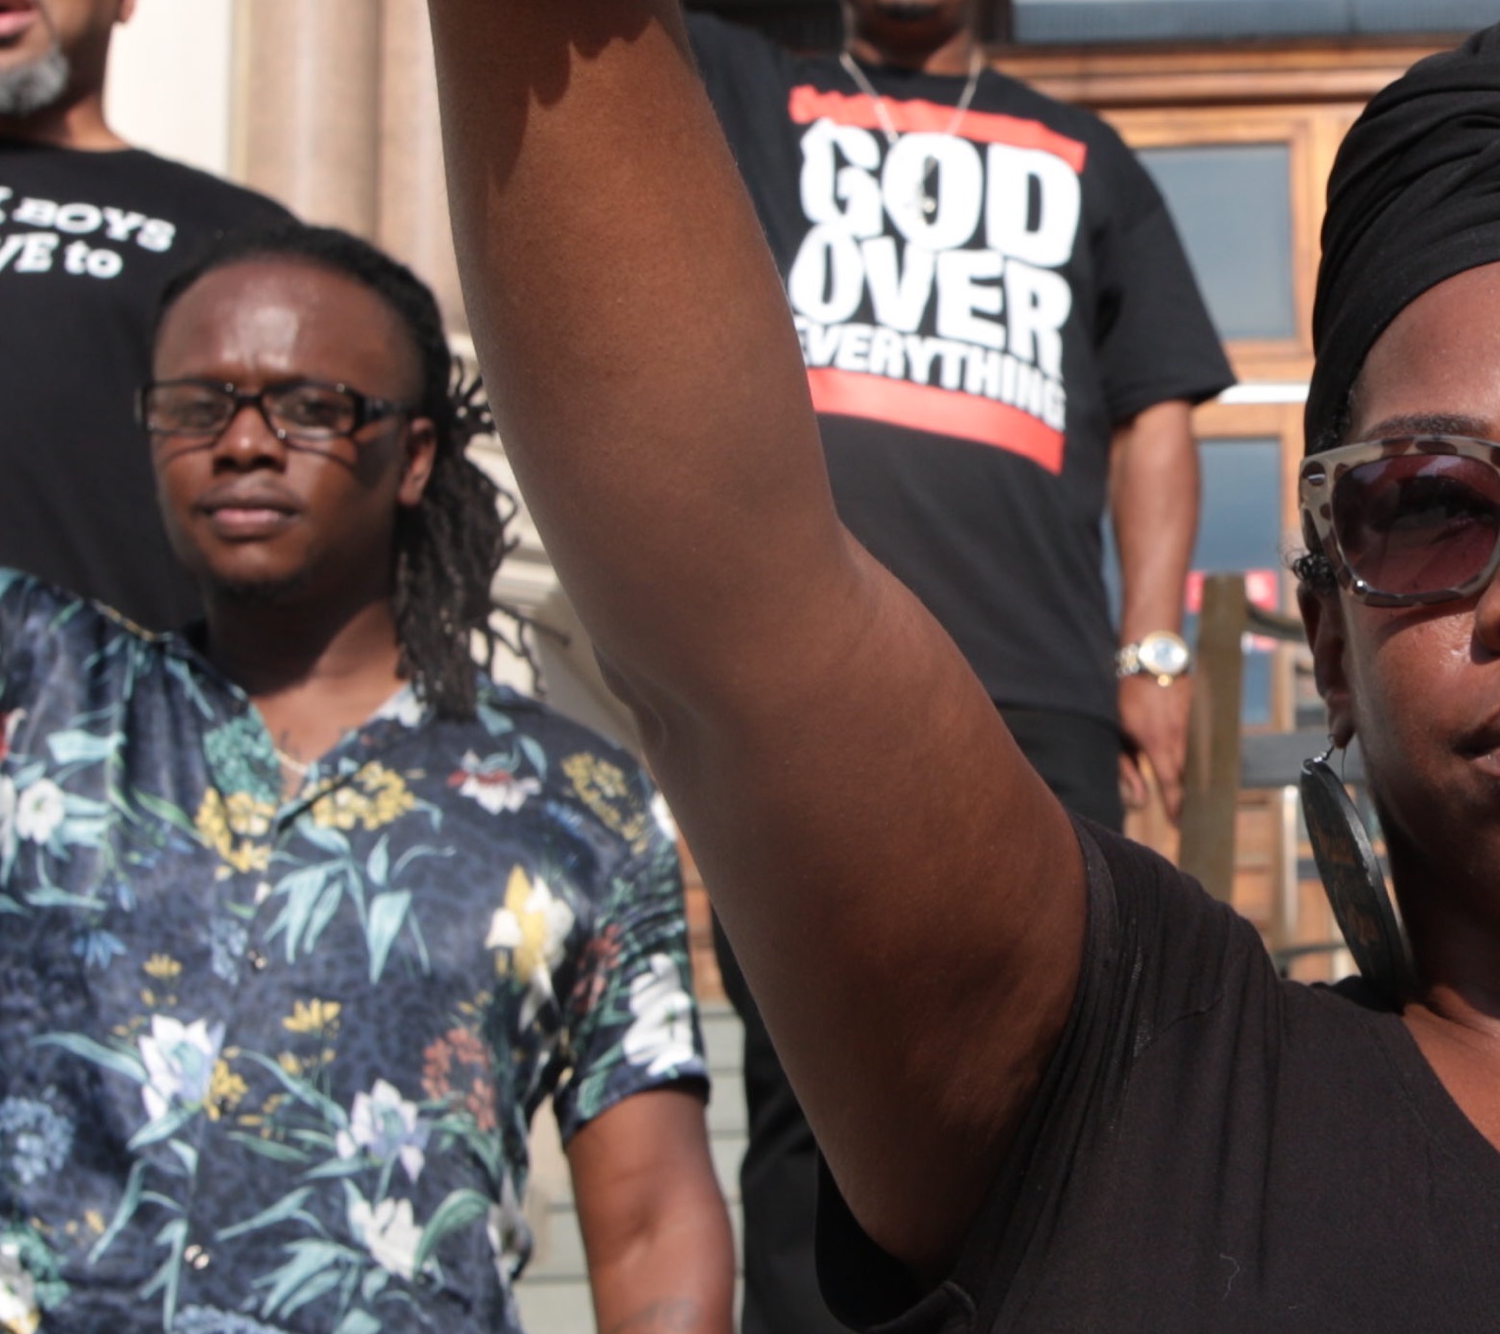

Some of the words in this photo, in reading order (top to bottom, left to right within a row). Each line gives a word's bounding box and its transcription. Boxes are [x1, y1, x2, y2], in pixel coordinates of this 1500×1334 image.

[13, 197, 176, 253] BOYS
[799, 117, 1081, 267] GOD
[65, 238, 123, 279] to
[789, 223, 1071, 377] OVER
